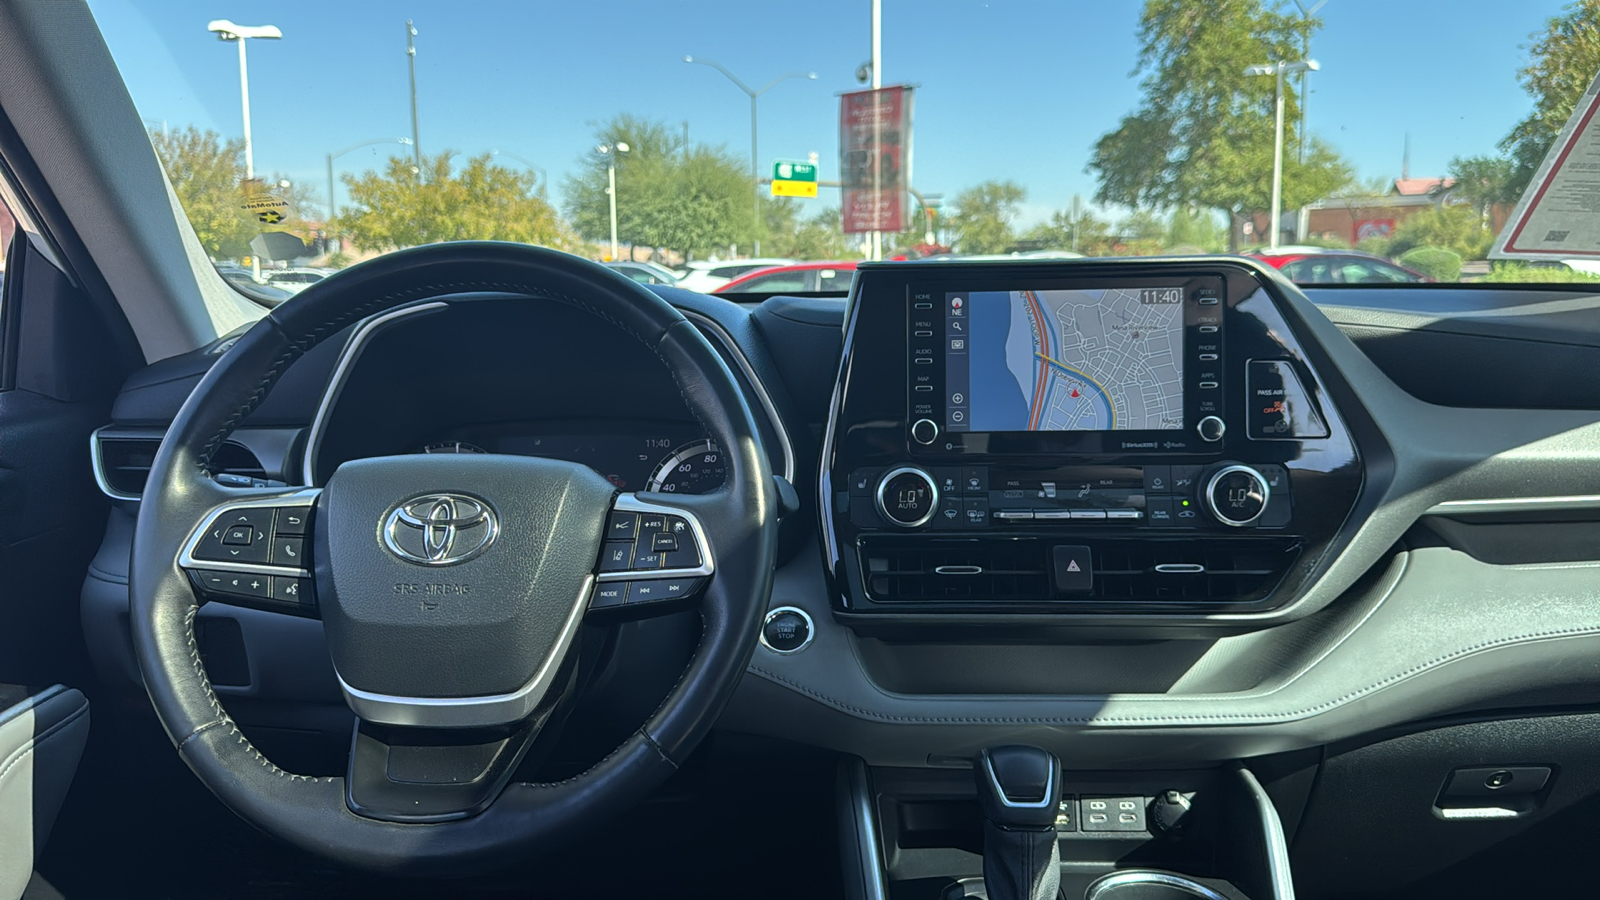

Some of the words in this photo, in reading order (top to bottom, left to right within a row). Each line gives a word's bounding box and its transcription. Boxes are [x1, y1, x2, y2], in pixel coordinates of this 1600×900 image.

[1143, 290, 1179, 303] 11:40
[646, 439, 671, 448] 11:40
[704, 455, 717, 463] 80
[679, 464, 692, 472] 60
[662, 484, 676, 492] 40
[899, 490, 916, 503] LO
[1229, 489, 1246, 502] LO
[393, 583, 418, 594] SRS
[424, 583, 471, 595] AIRBAG
